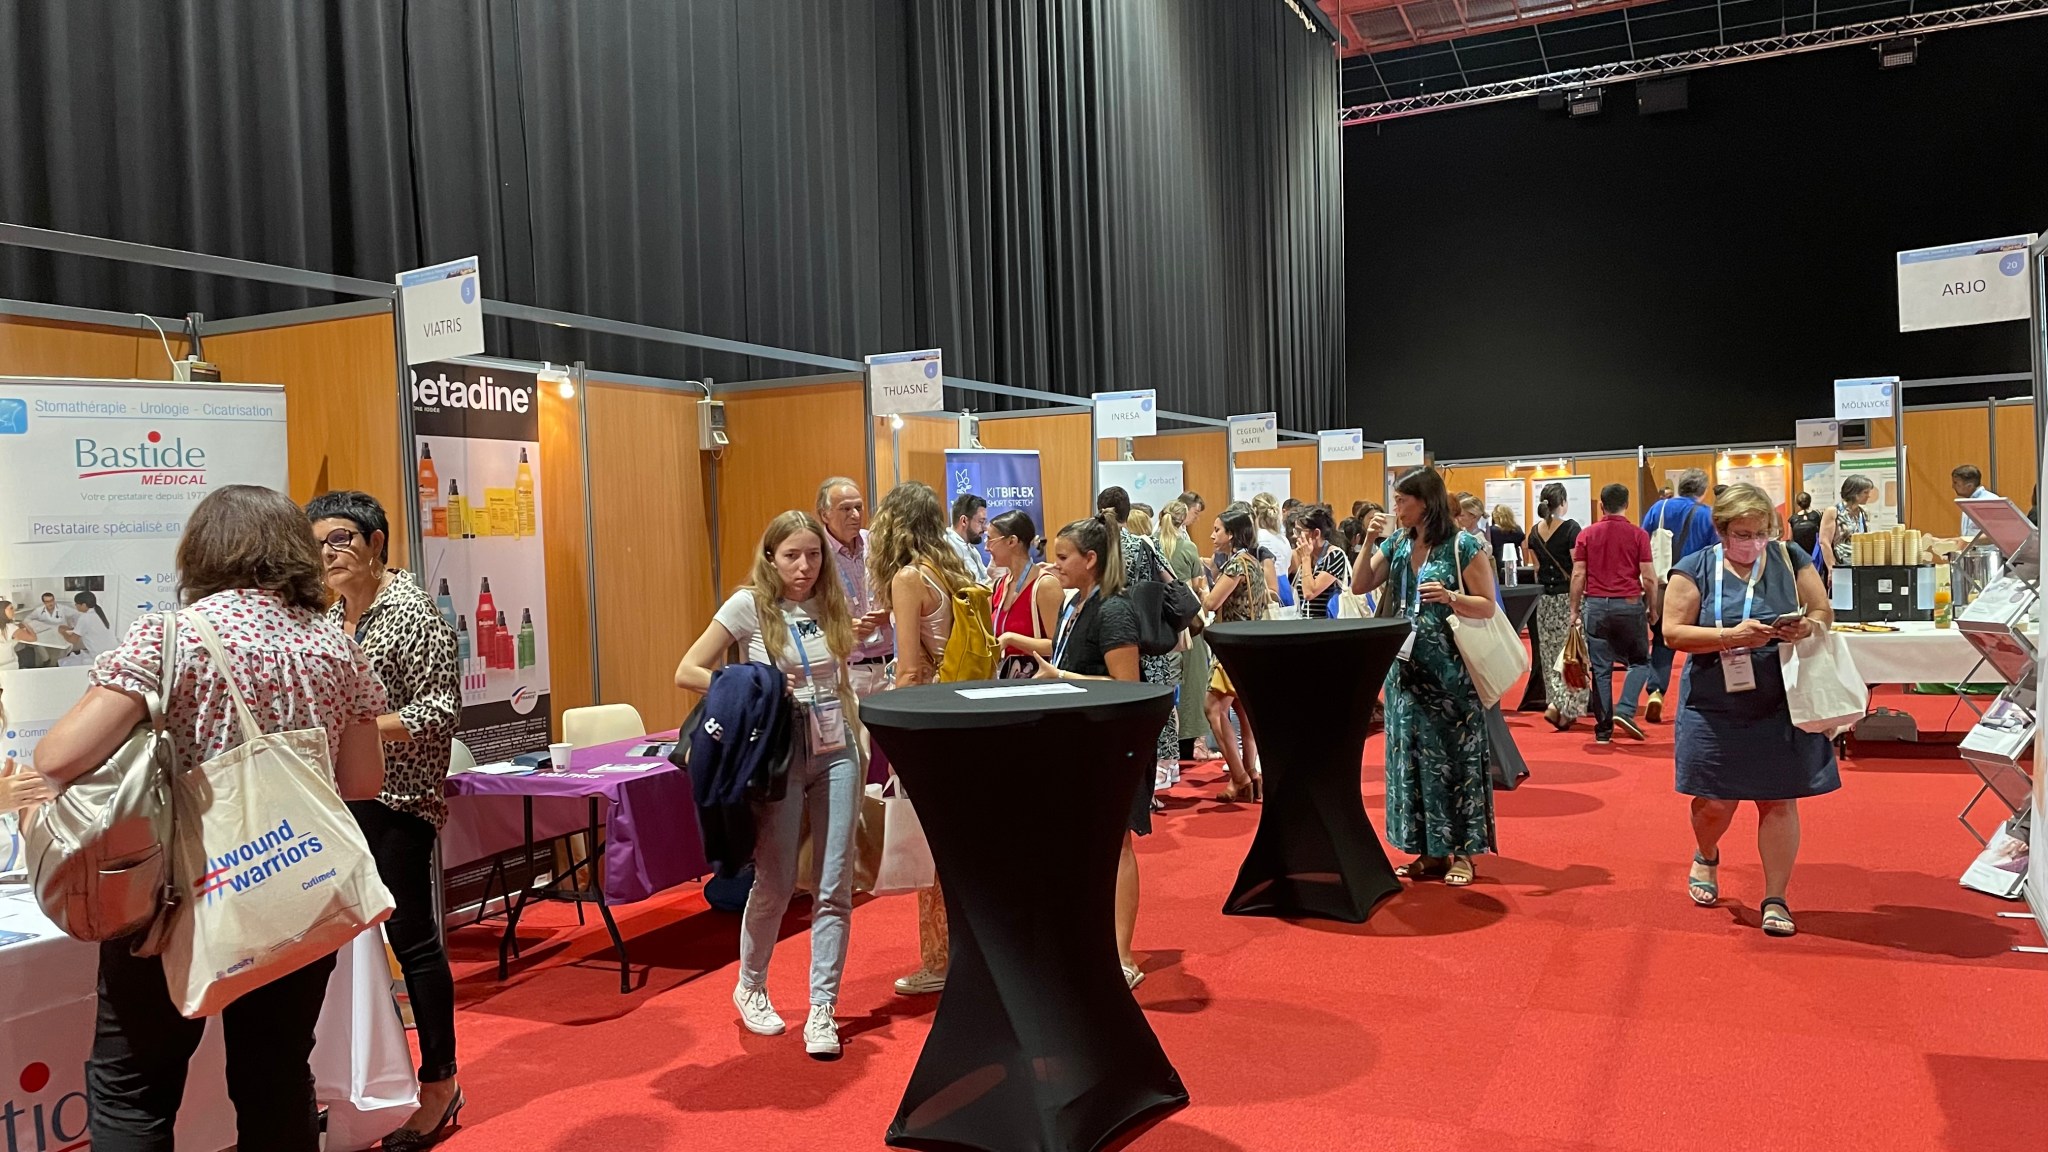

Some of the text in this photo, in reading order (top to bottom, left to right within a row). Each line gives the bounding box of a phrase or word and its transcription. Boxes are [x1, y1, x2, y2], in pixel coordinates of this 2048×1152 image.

[2006, 261, 2018, 270] 20
[1941, 279, 1986, 297] ARJO
[423, 317, 462, 338] VIATRIS
[883, 383, 929, 397] THUASNE
[35, 399, 127, 415] Stomathérapie
[140, 402, 189, 417] Urologie
[202, 403, 273, 417] Cicatrisation
[1841, 399, 1890, 409] MÖLNLYCKE
[1111, 412, 1140, 421] INRESA
[1236, 426, 1265, 436] CEGEDIM
[1240, 437, 1261, 445] SANTE
[75, 430, 206, 468] Bastide
[141, 472, 207, 485] MÉDICAL
[1149, 477, 1175, 485] sorbact
[80, 492, 105, 501] Votre
[108, 492, 154, 502] prestataire
[156, 491, 184, 502] depuis
[986, 486, 1034, 498] KITBIFLEX
[987, 499, 1034, 507] SHORT STRETCH
[33, 520, 181, 536] Prestataire spécialisé en
[228, 836, 323, 893] warriors
[301, 867, 337, 890] Cutimed
